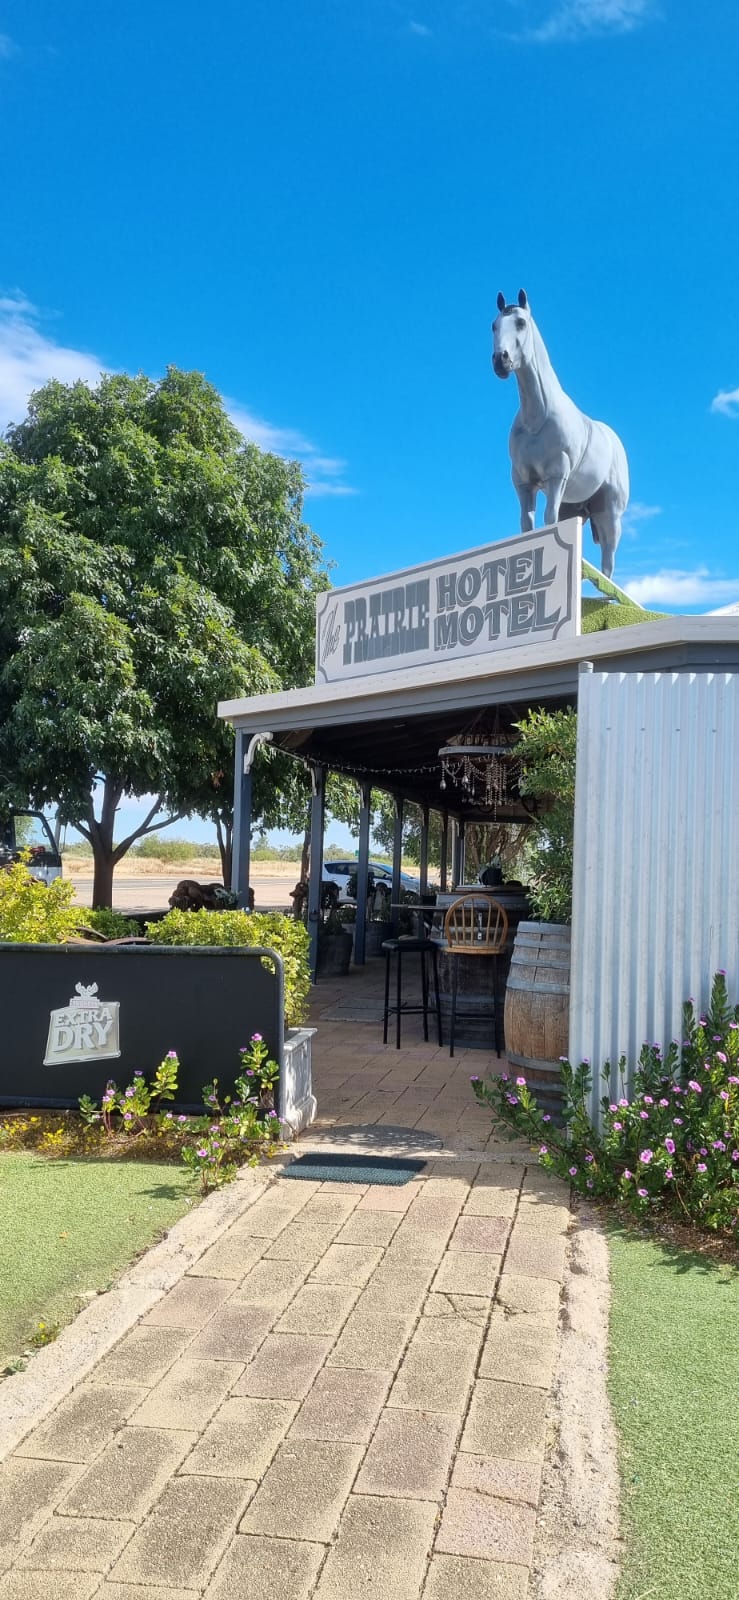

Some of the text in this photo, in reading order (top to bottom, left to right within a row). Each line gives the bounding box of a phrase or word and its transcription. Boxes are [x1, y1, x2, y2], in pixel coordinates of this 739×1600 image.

[436, 546, 557, 613] HOTEL
[321, 577, 430, 665] The PRAIRIE
[433, 590, 561, 651] MOTEL
[51, 1020, 113, 1052] DRY
[55, 1007, 113, 1026] EXTRA
